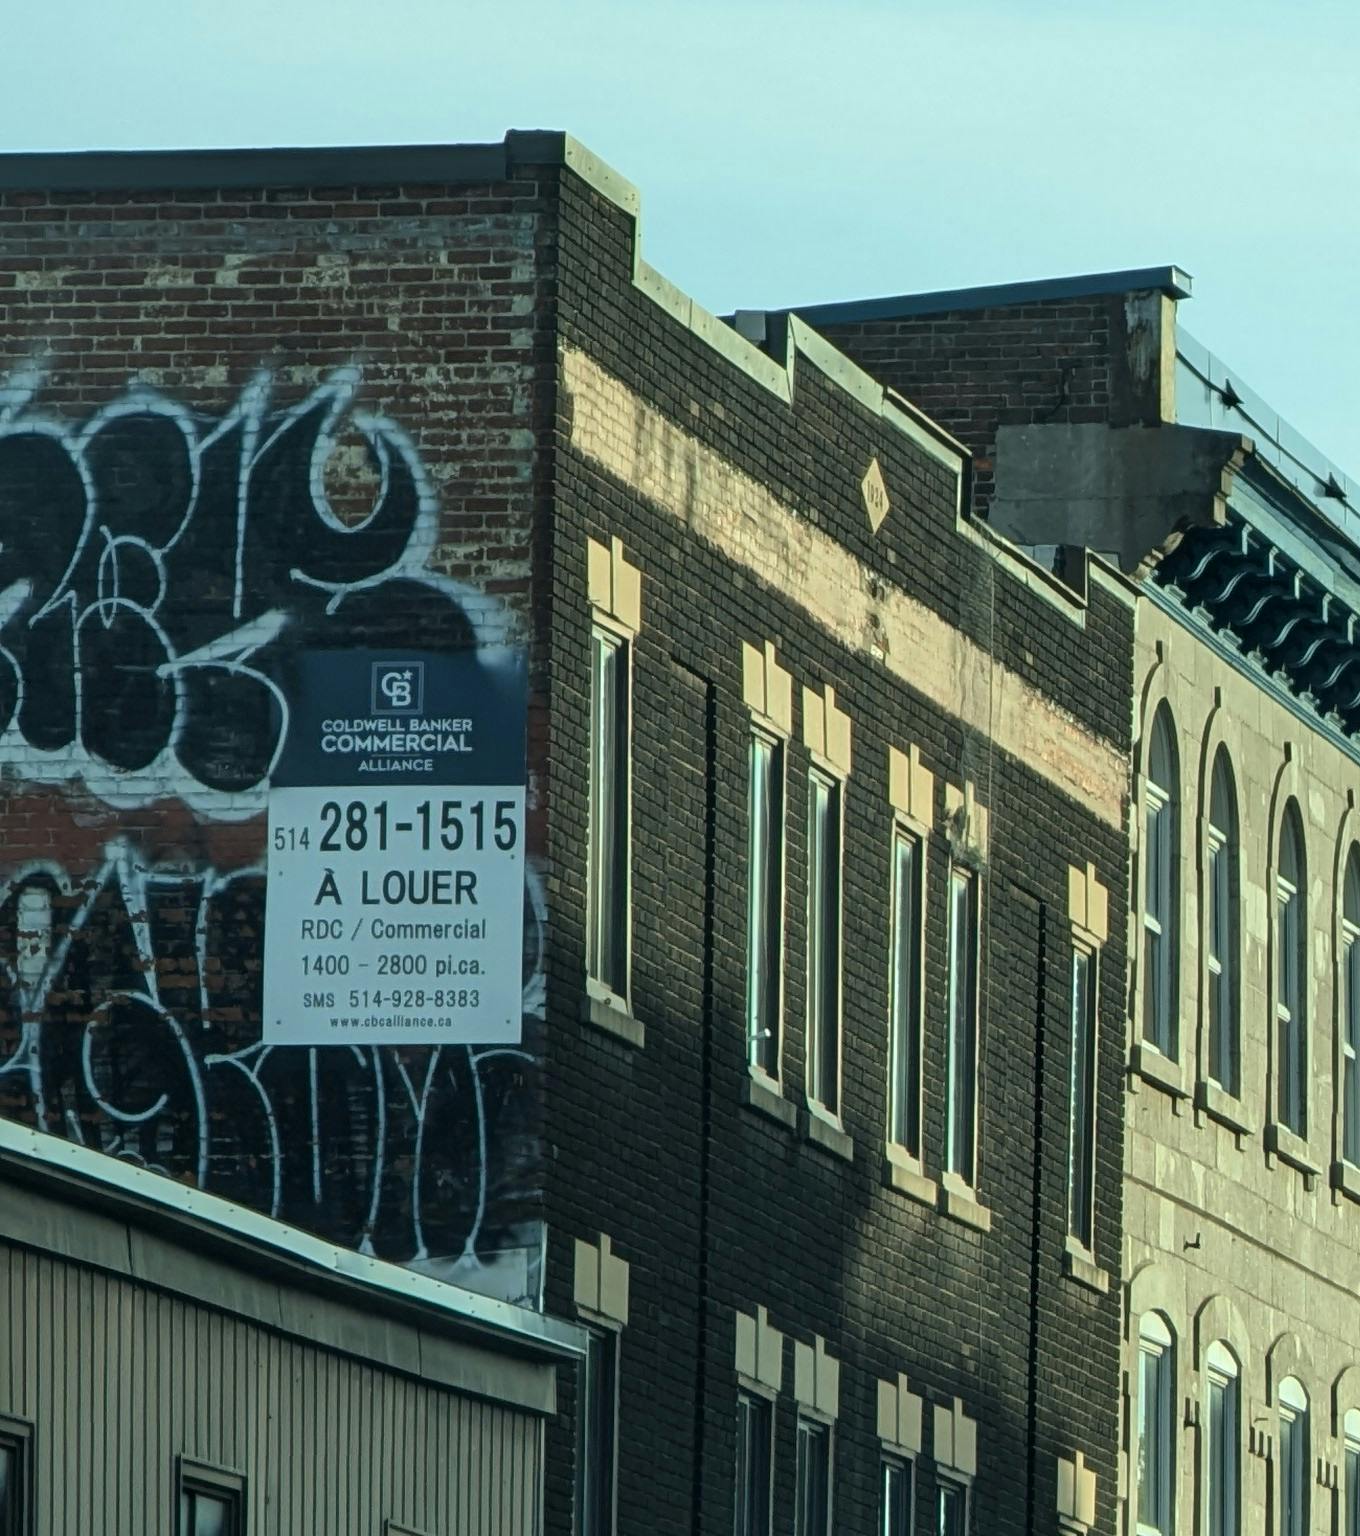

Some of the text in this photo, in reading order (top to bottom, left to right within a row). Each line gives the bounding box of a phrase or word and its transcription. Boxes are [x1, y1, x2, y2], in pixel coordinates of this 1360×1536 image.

[321, 718, 473, 733] COLDWELL BANKER
[321, 734, 473, 752] COMMERCIAL
[358, 758, 433, 771] ALLIANCE
[274, 800, 517, 852] 514 281-1515
[361, 870, 478, 905] LOUER
[301, 919, 343, 939] RDC
[371, 918, 486, 939] Commercial
[301, 955, 349, 975] 1400
[377, 955, 427, 975] 2800
[435, 954, 486, 978] pi.ca.
[303, 990, 480, 1008] SMS 514-928-8383
